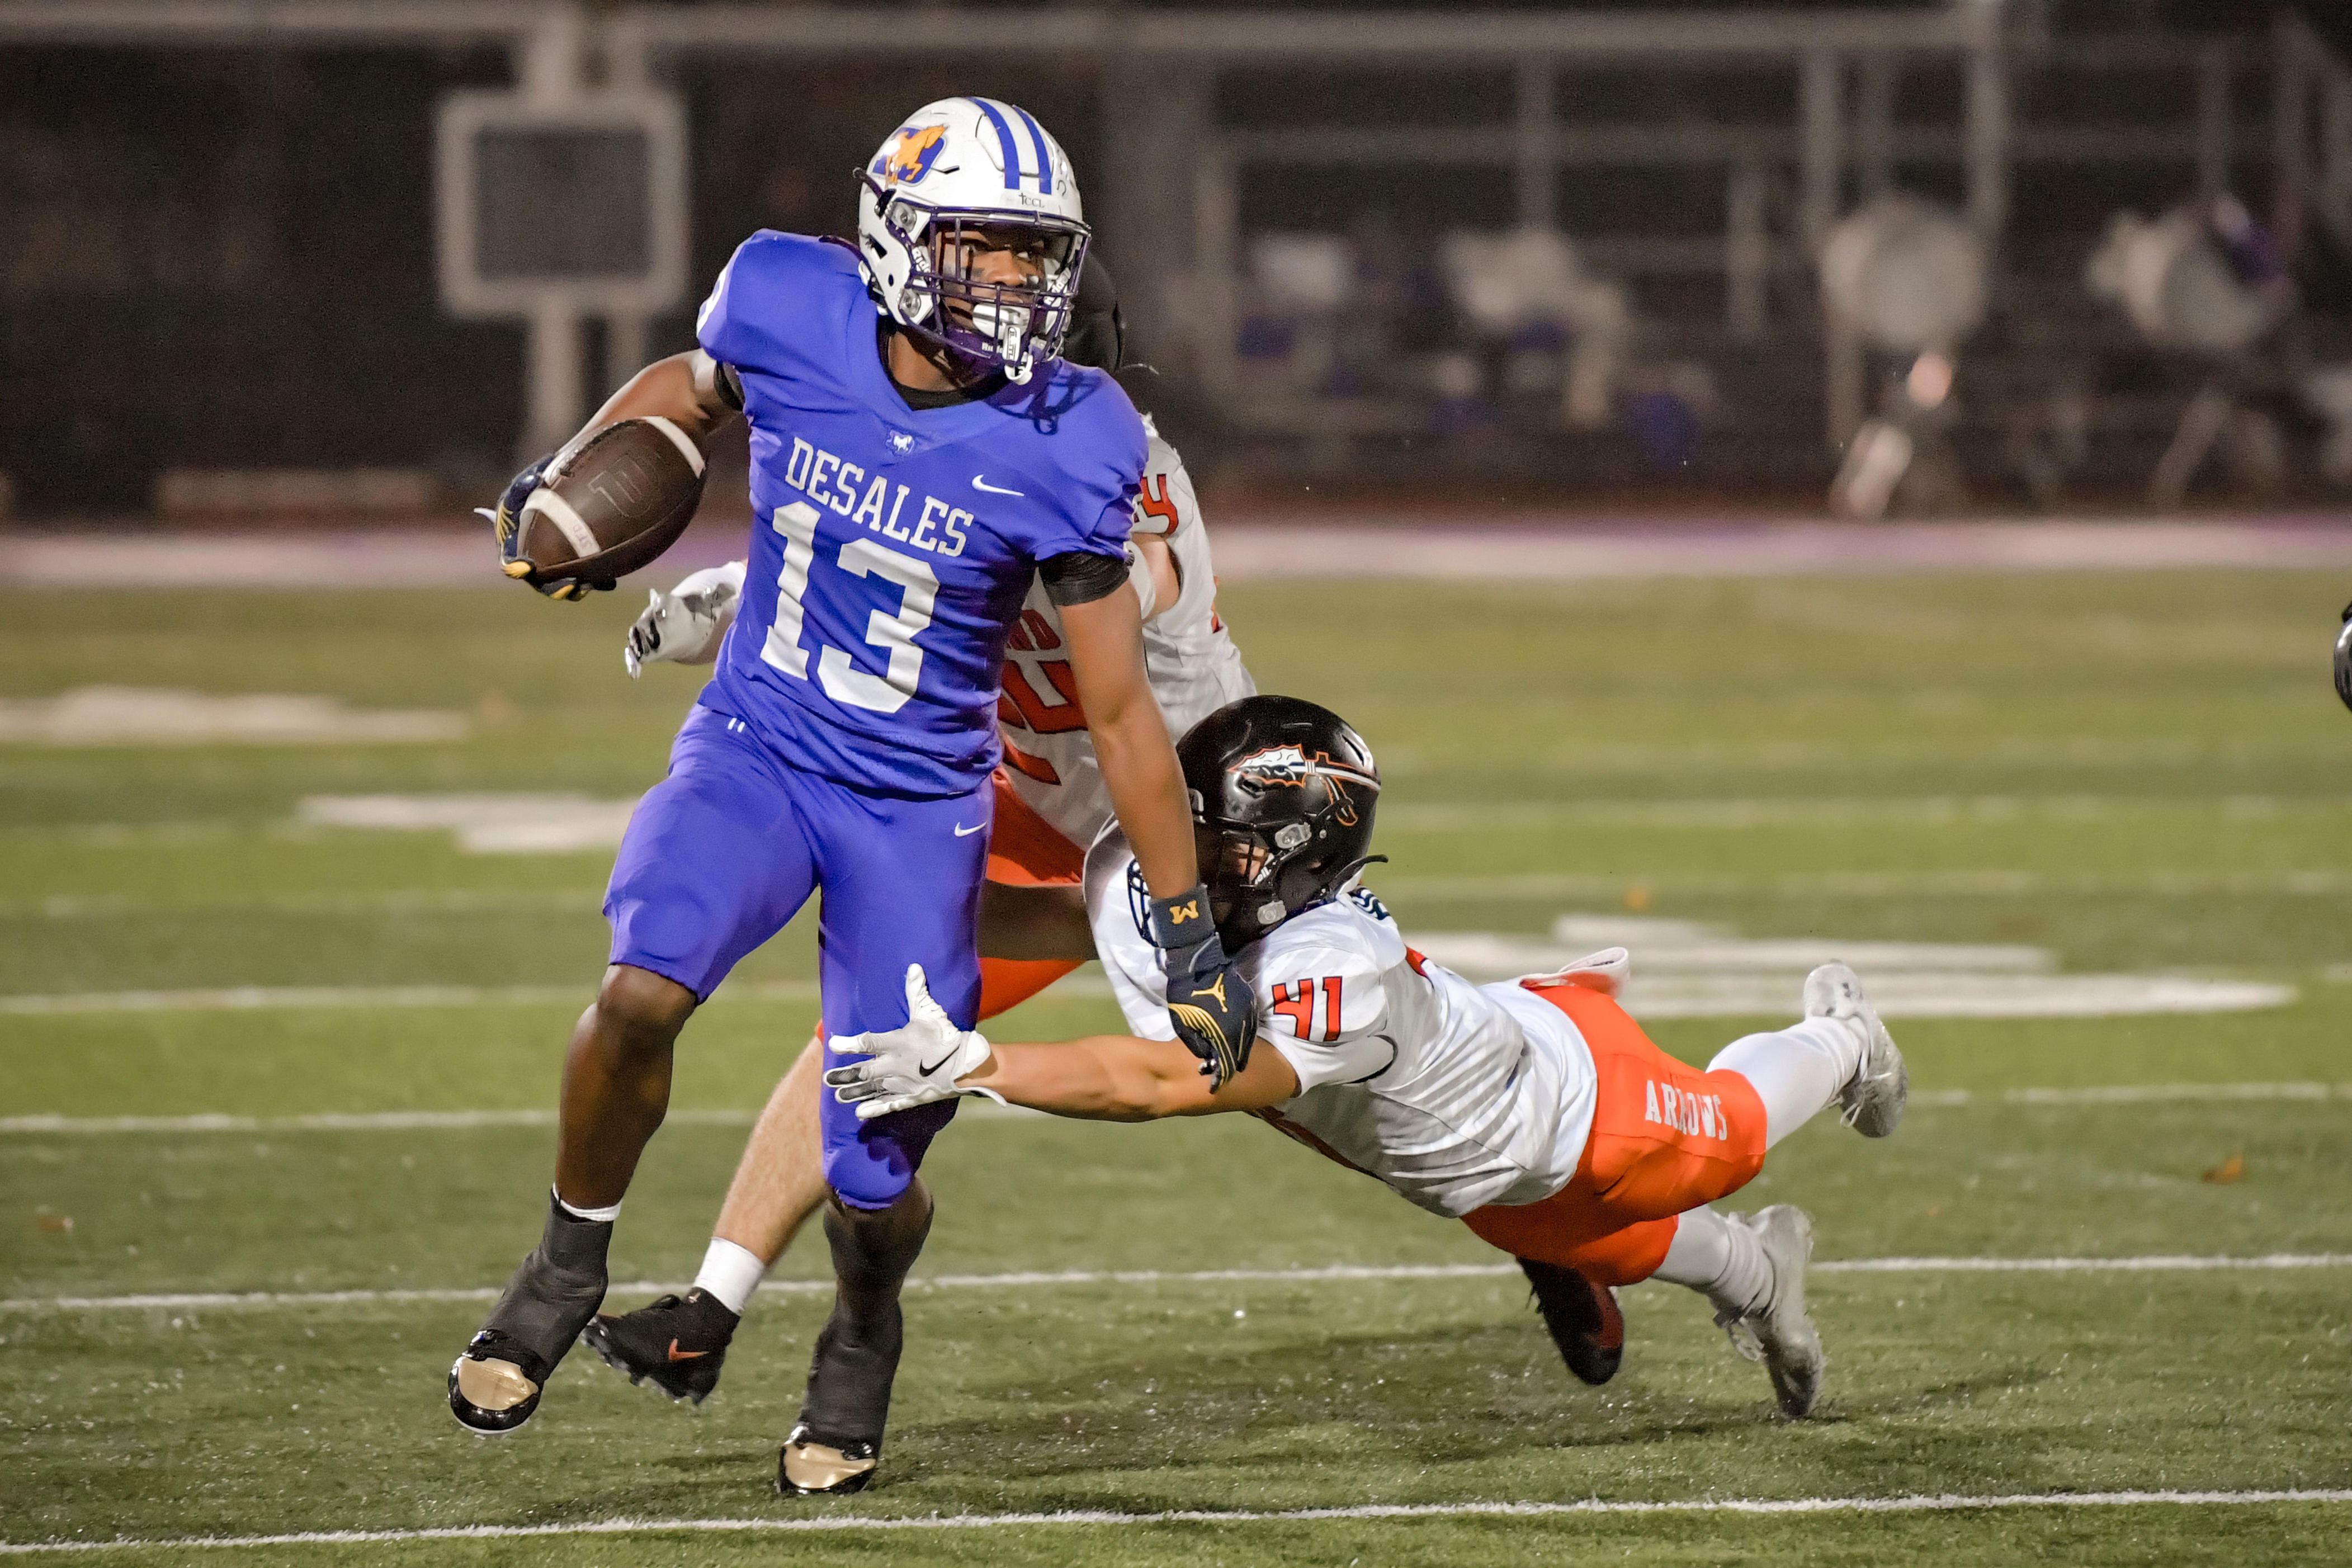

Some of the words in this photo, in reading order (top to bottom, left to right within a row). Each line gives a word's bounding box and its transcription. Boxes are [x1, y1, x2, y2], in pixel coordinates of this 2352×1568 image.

[785, 436, 975, 558] DESALES
[760, 500, 940, 714] 13
[1169, 900, 1199, 924] M
[1271, 975, 1343, 1042] 41
[1645, 1079, 1728, 1141] ARROWS
